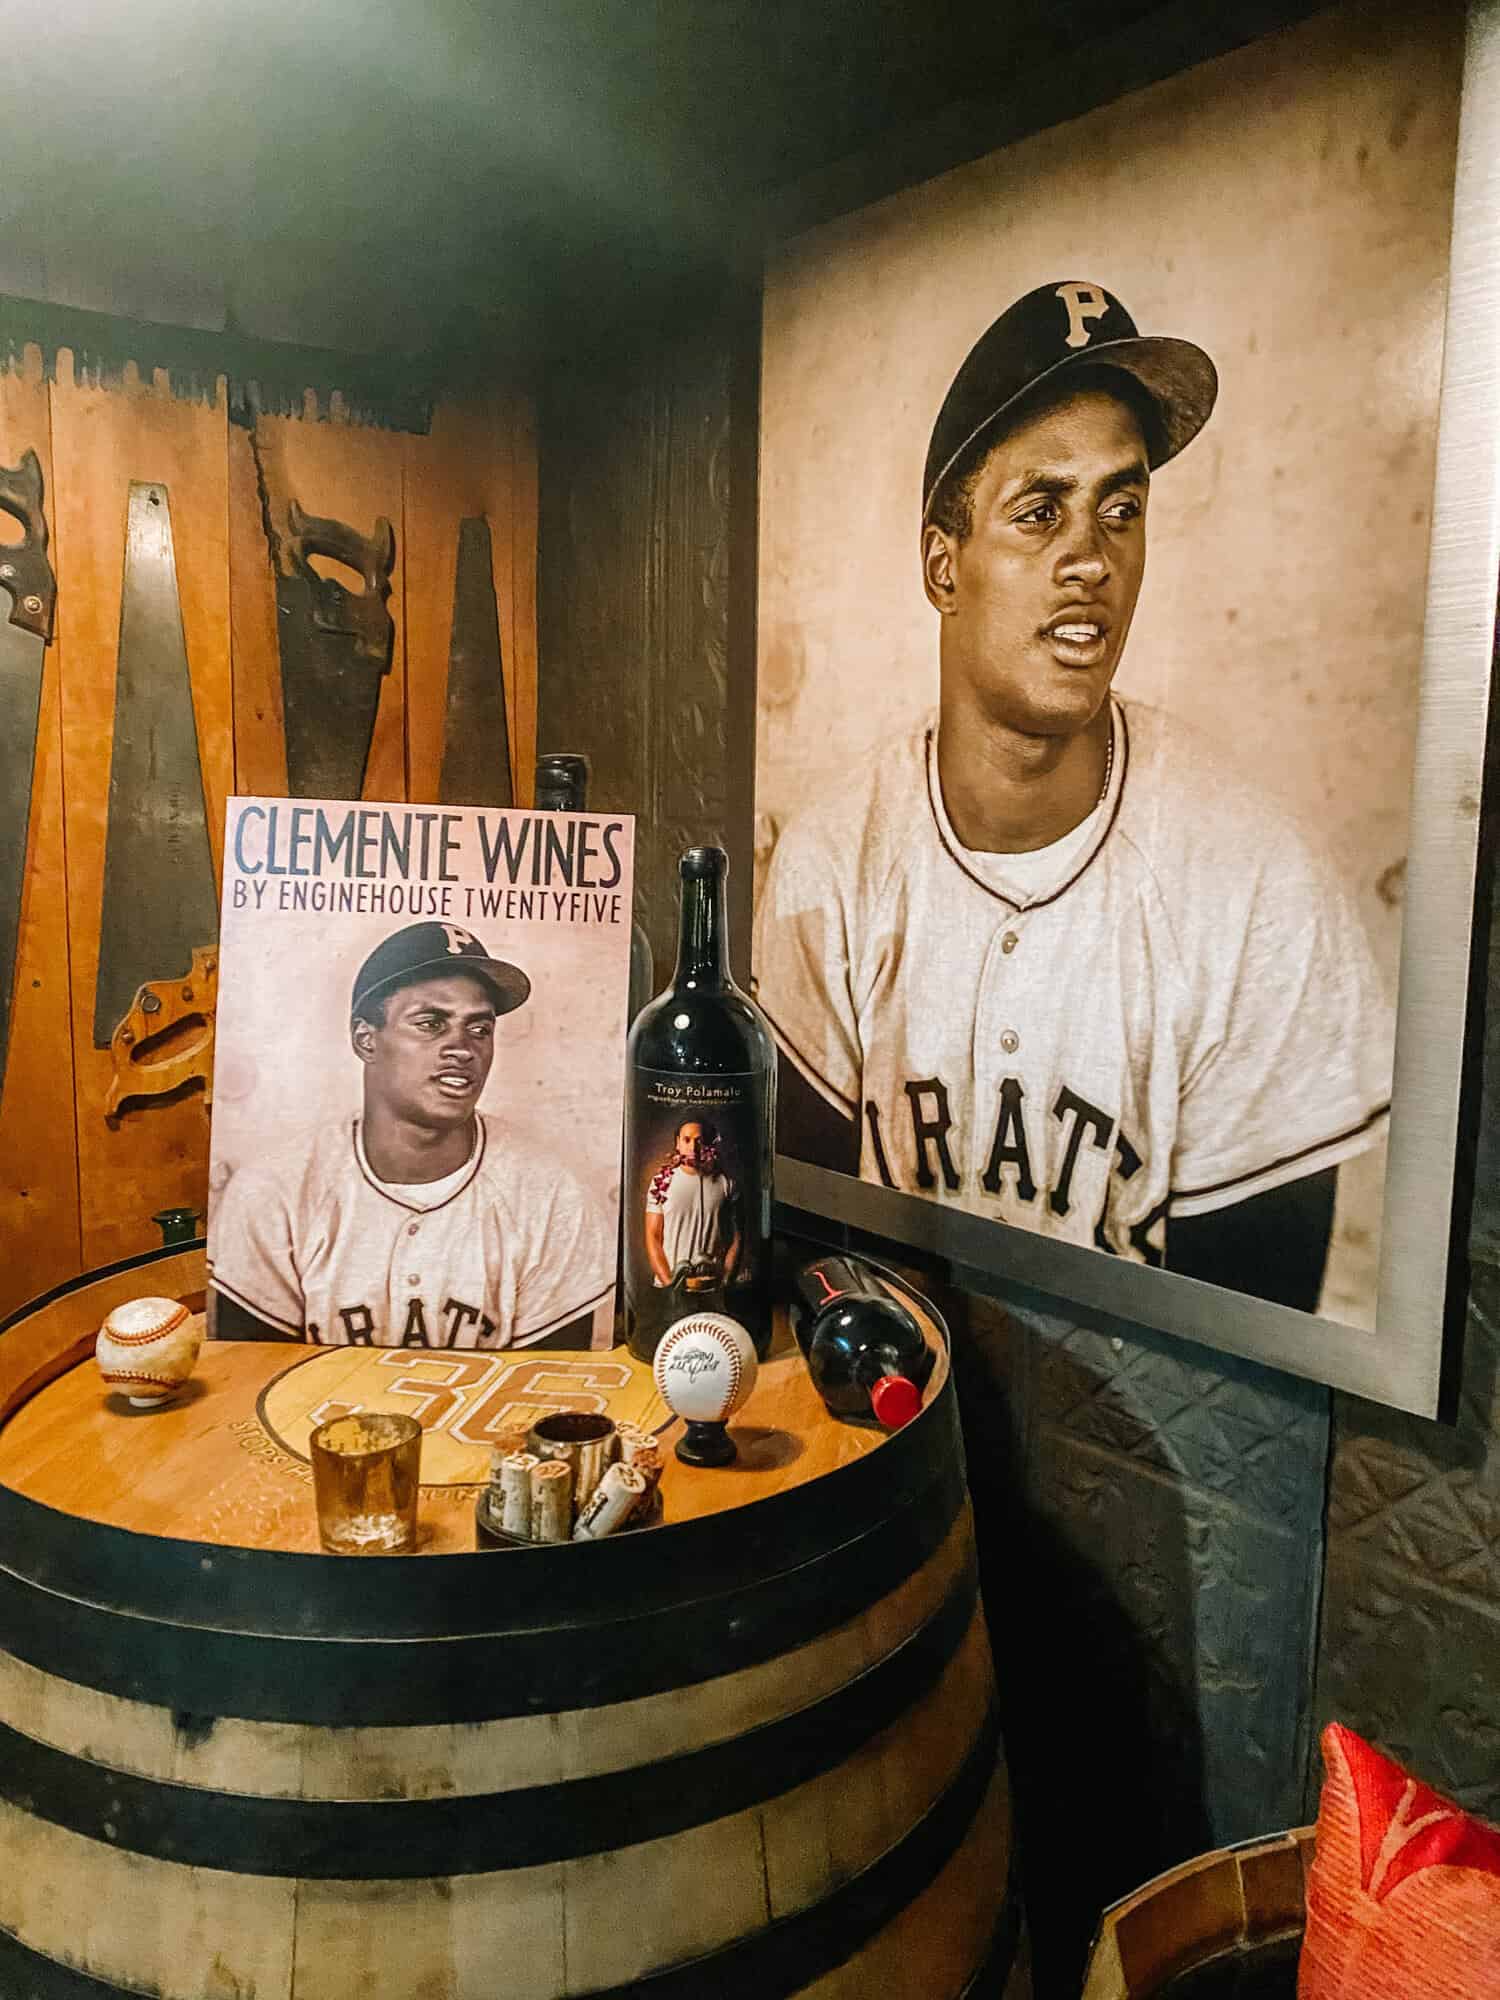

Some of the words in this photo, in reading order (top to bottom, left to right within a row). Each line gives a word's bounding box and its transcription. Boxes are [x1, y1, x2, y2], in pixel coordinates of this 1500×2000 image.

[1056, 282, 1109, 347] P
[234, 805, 462, 882] CLEMENTE
[477, 814, 623, 889] WINES
[233, 879, 268, 909] BY
[279, 880, 452, 917] ENGINEHOUSE
[463, 888, 622, 924] TWENTYFIVE
[440, 924, 473, 954] P
[655, 1082, 682, 1098] Troy
[307, 1349, 633, 1447] 36
